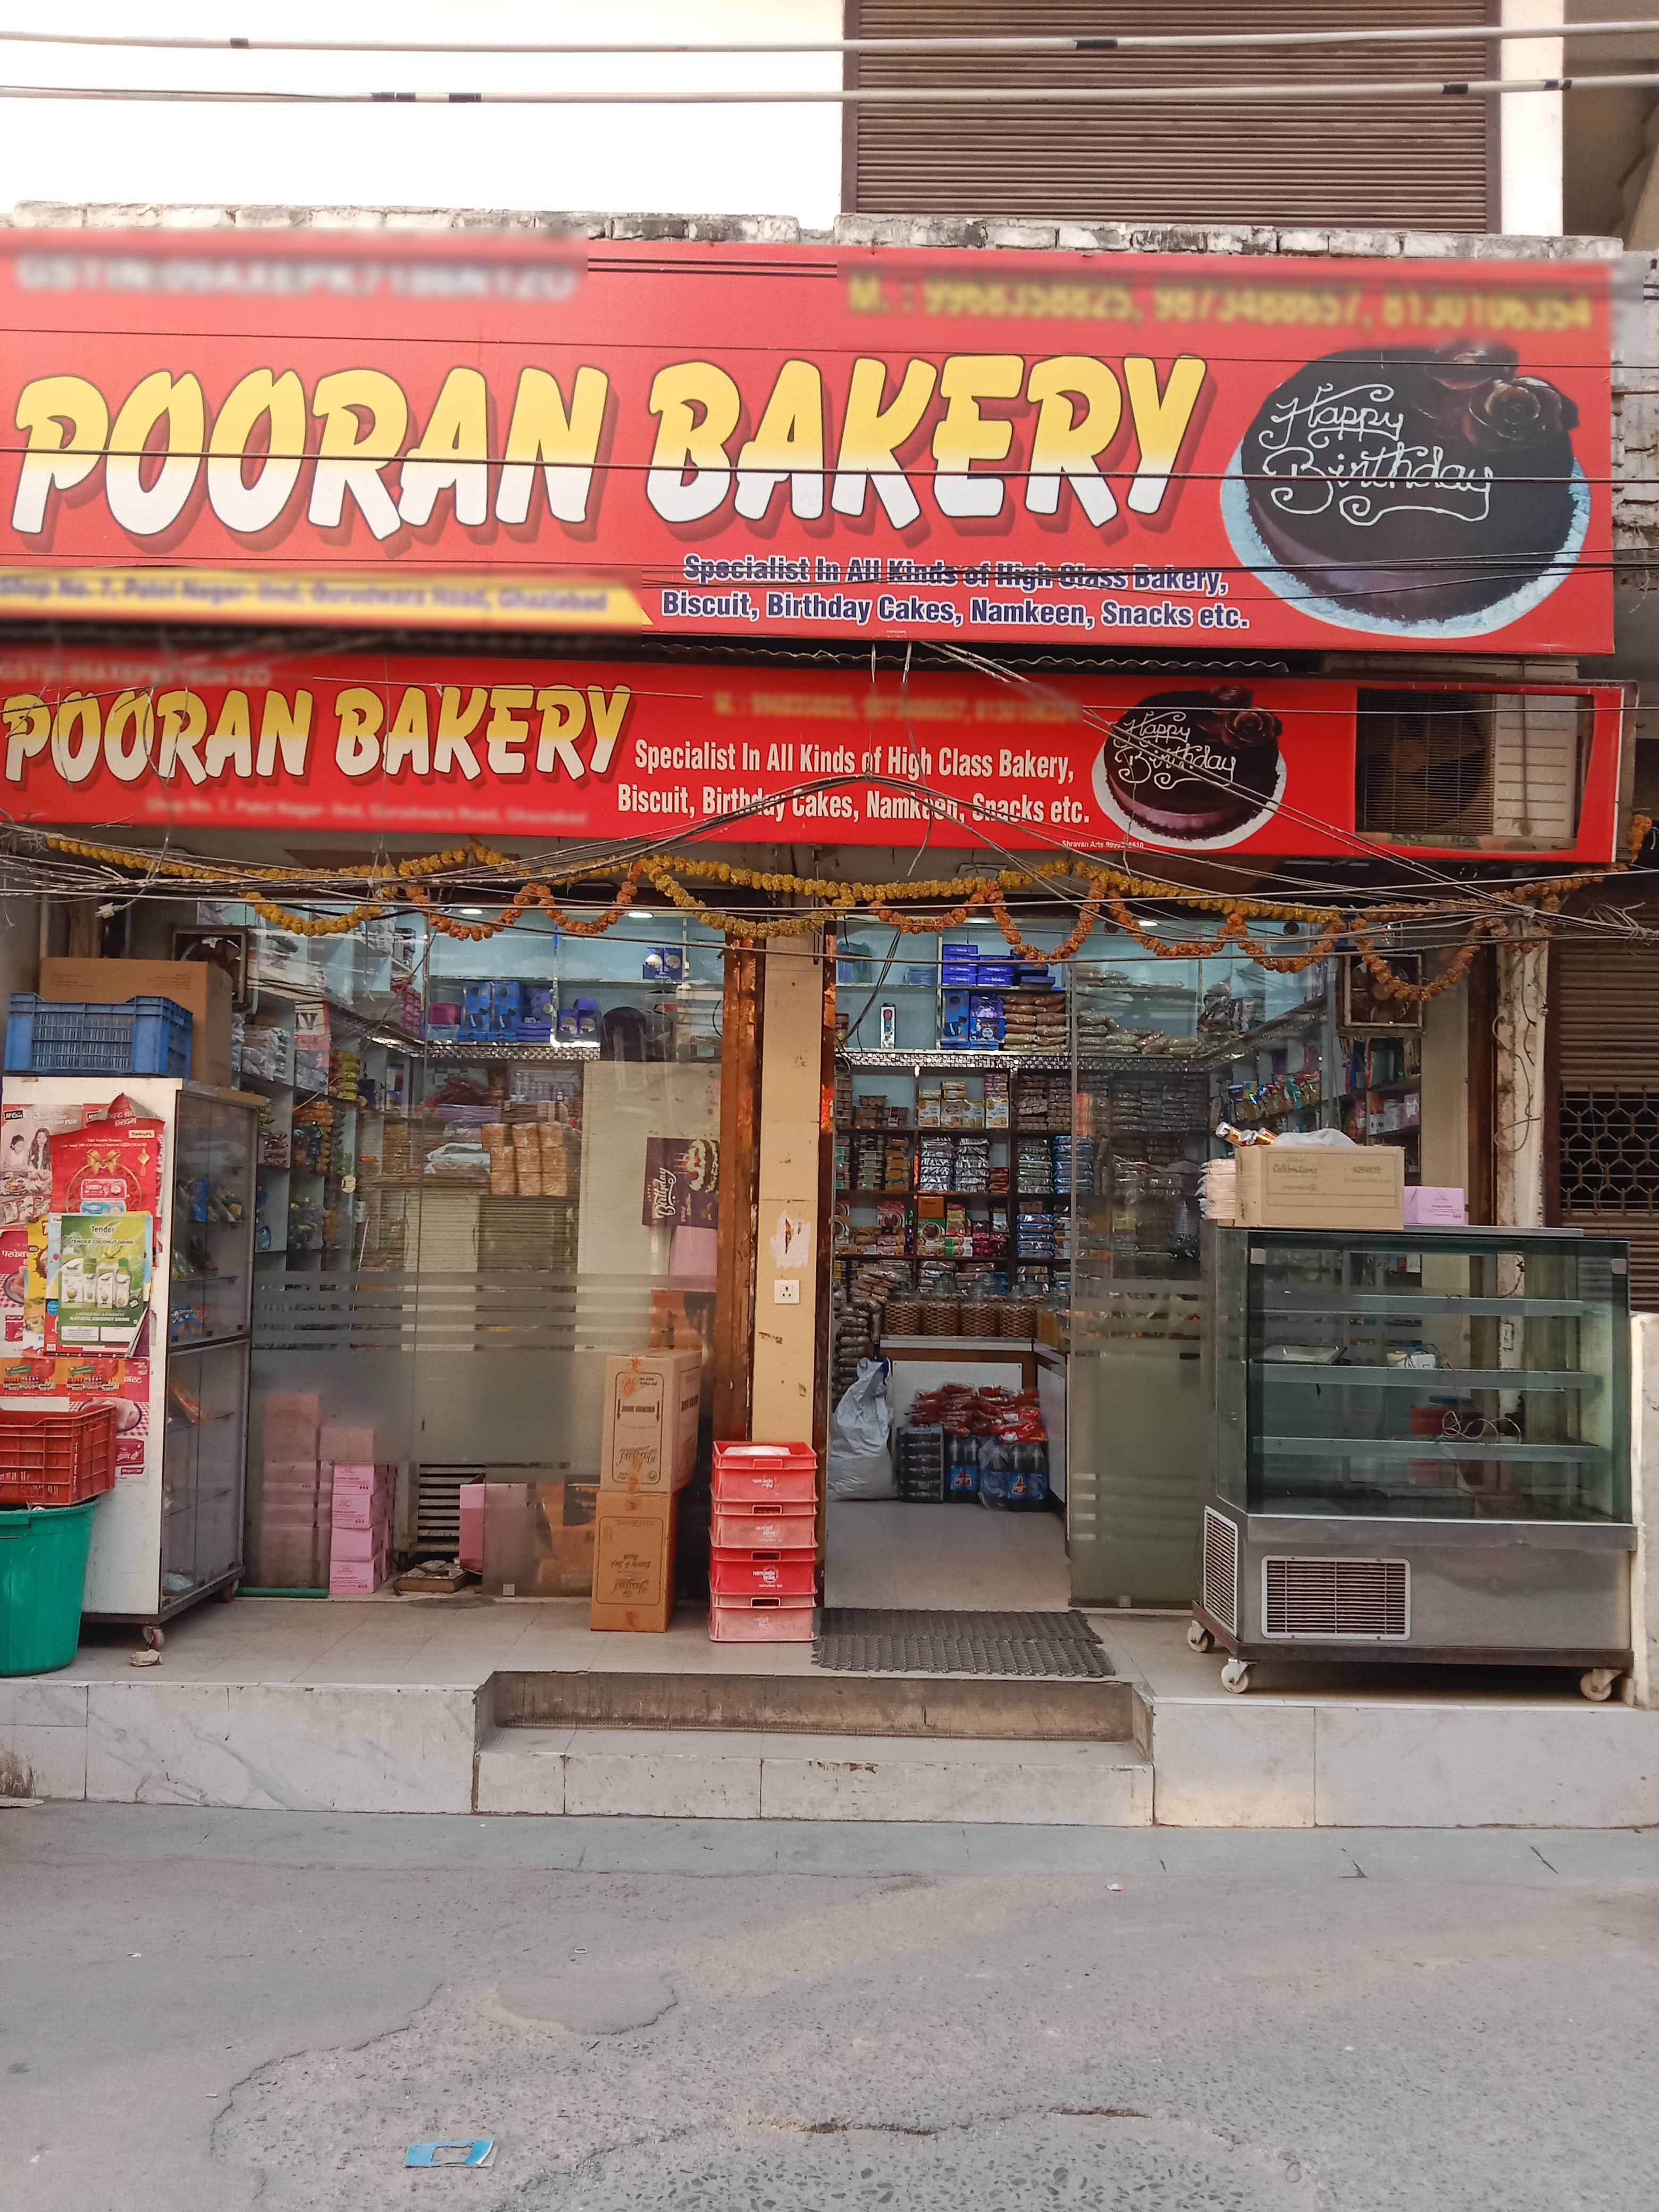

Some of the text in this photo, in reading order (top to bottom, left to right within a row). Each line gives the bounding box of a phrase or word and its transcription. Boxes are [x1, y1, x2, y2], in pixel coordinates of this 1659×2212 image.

[1258, 383, 1405, 449] Happy
[11, 354, 1207, 541] POORAN BAKERY
[1261, 441, 1495, 526] Birthday
[683, 554, 1229, 596] Specialist In All Kinds of High Class Bakery,
[661, 590, 1251, 630] Biscuit, Birthday Cakes, Namkeen, Snacks etc.
[2, 684, 633, 786] POORAN BAKERY
[1113, 710, 1191, 749] Happy
[635, 739, 1074, 784] Specialist In All Kinds of High Class Bakery,
[617, 783, 696, 819] Biscuit,
[702, 785, 786, 822] Birthday
[792, 787, 859, 823] Cakes,
[867, 790, 965, 824] Namkeen,
[971, 792, 1044, 824] Snacks
[1050, 795, 1090, 824] etc.
